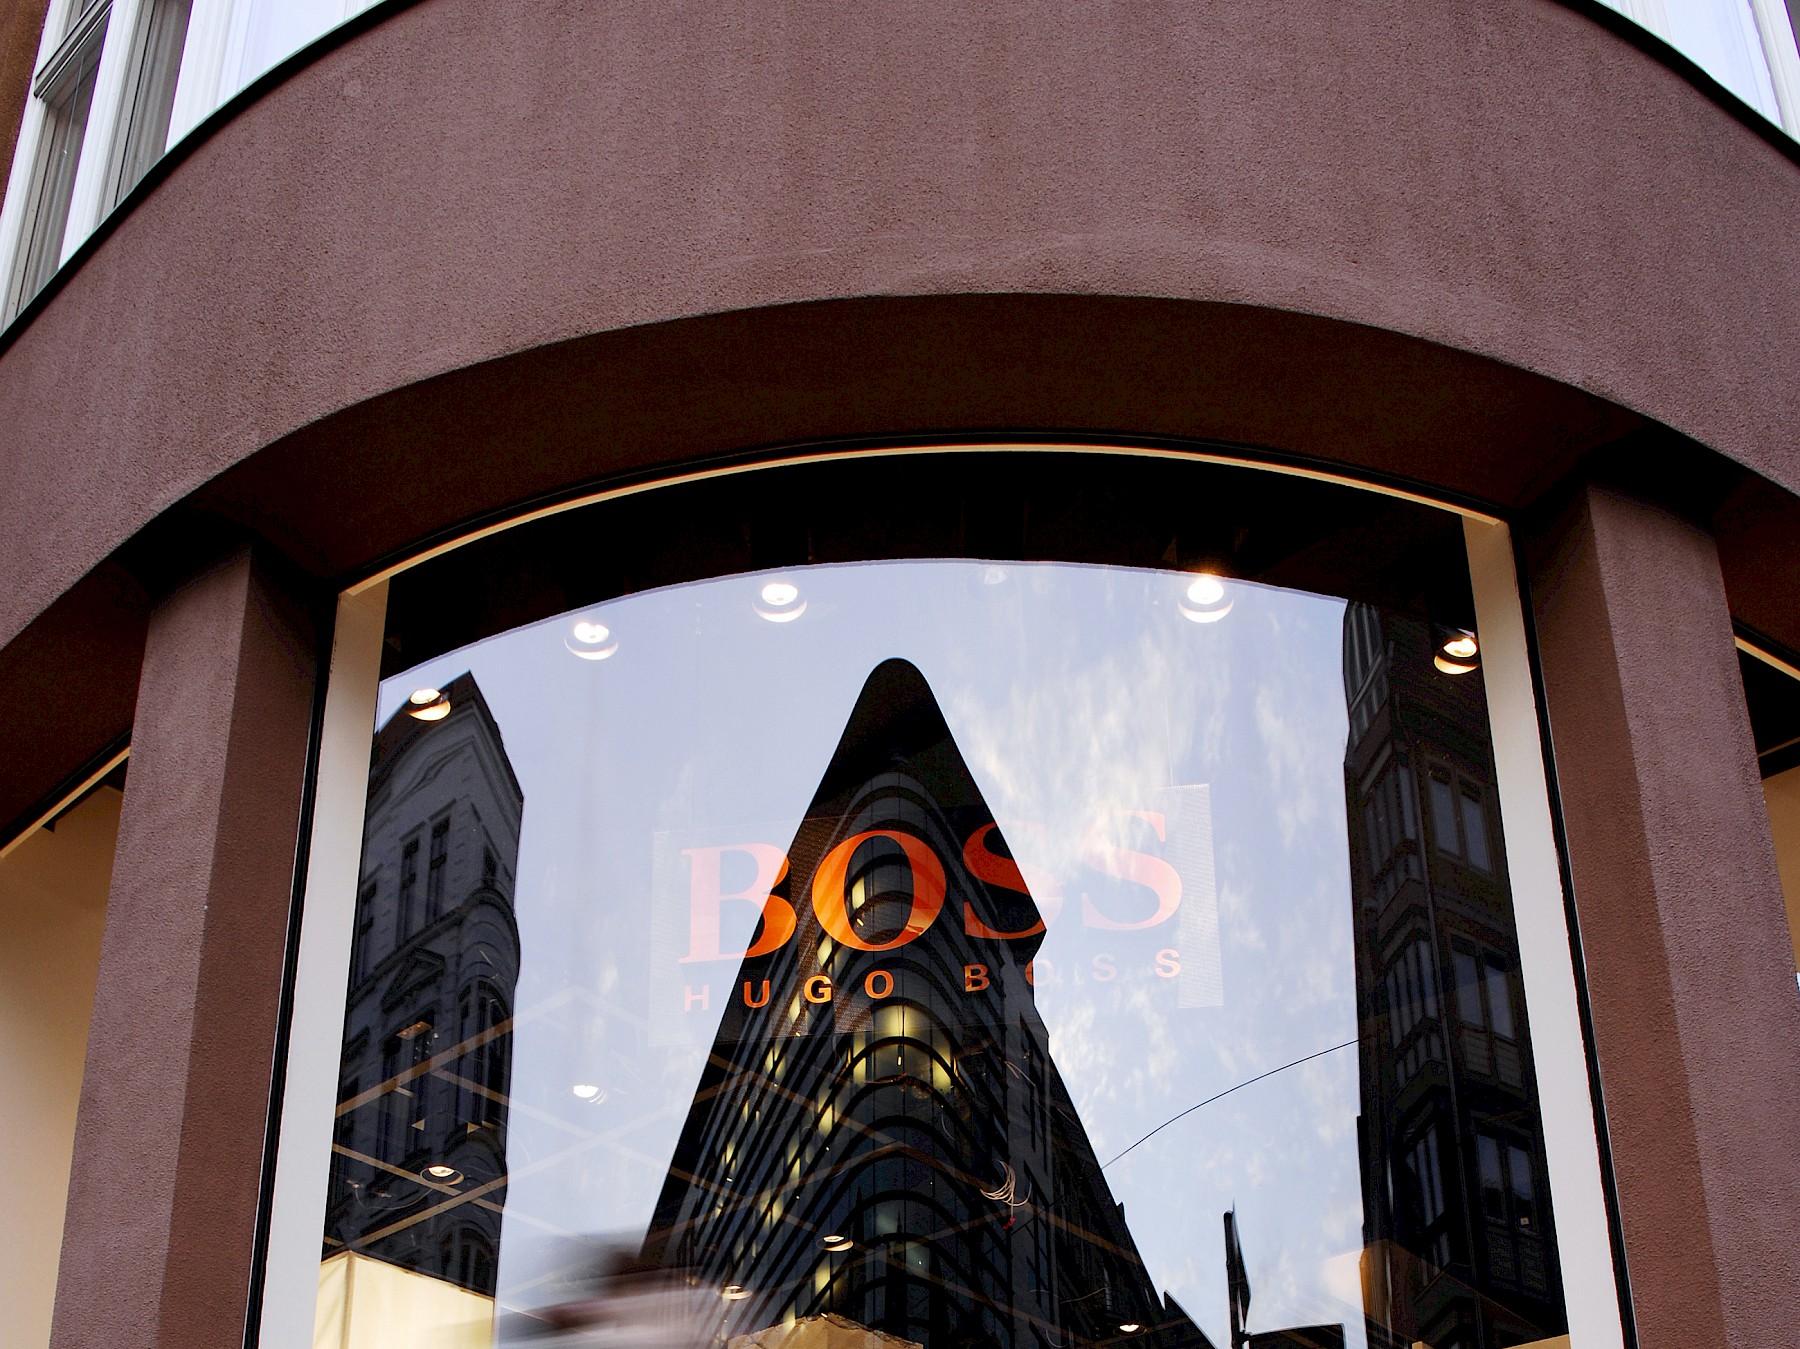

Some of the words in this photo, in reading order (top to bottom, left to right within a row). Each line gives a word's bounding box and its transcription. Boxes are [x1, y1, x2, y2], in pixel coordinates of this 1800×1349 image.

[678, 811, 1183, 963] BOSS
[684, 970, 895, 1011] HUGO
[964, 948, 1182, 992] BOSS
